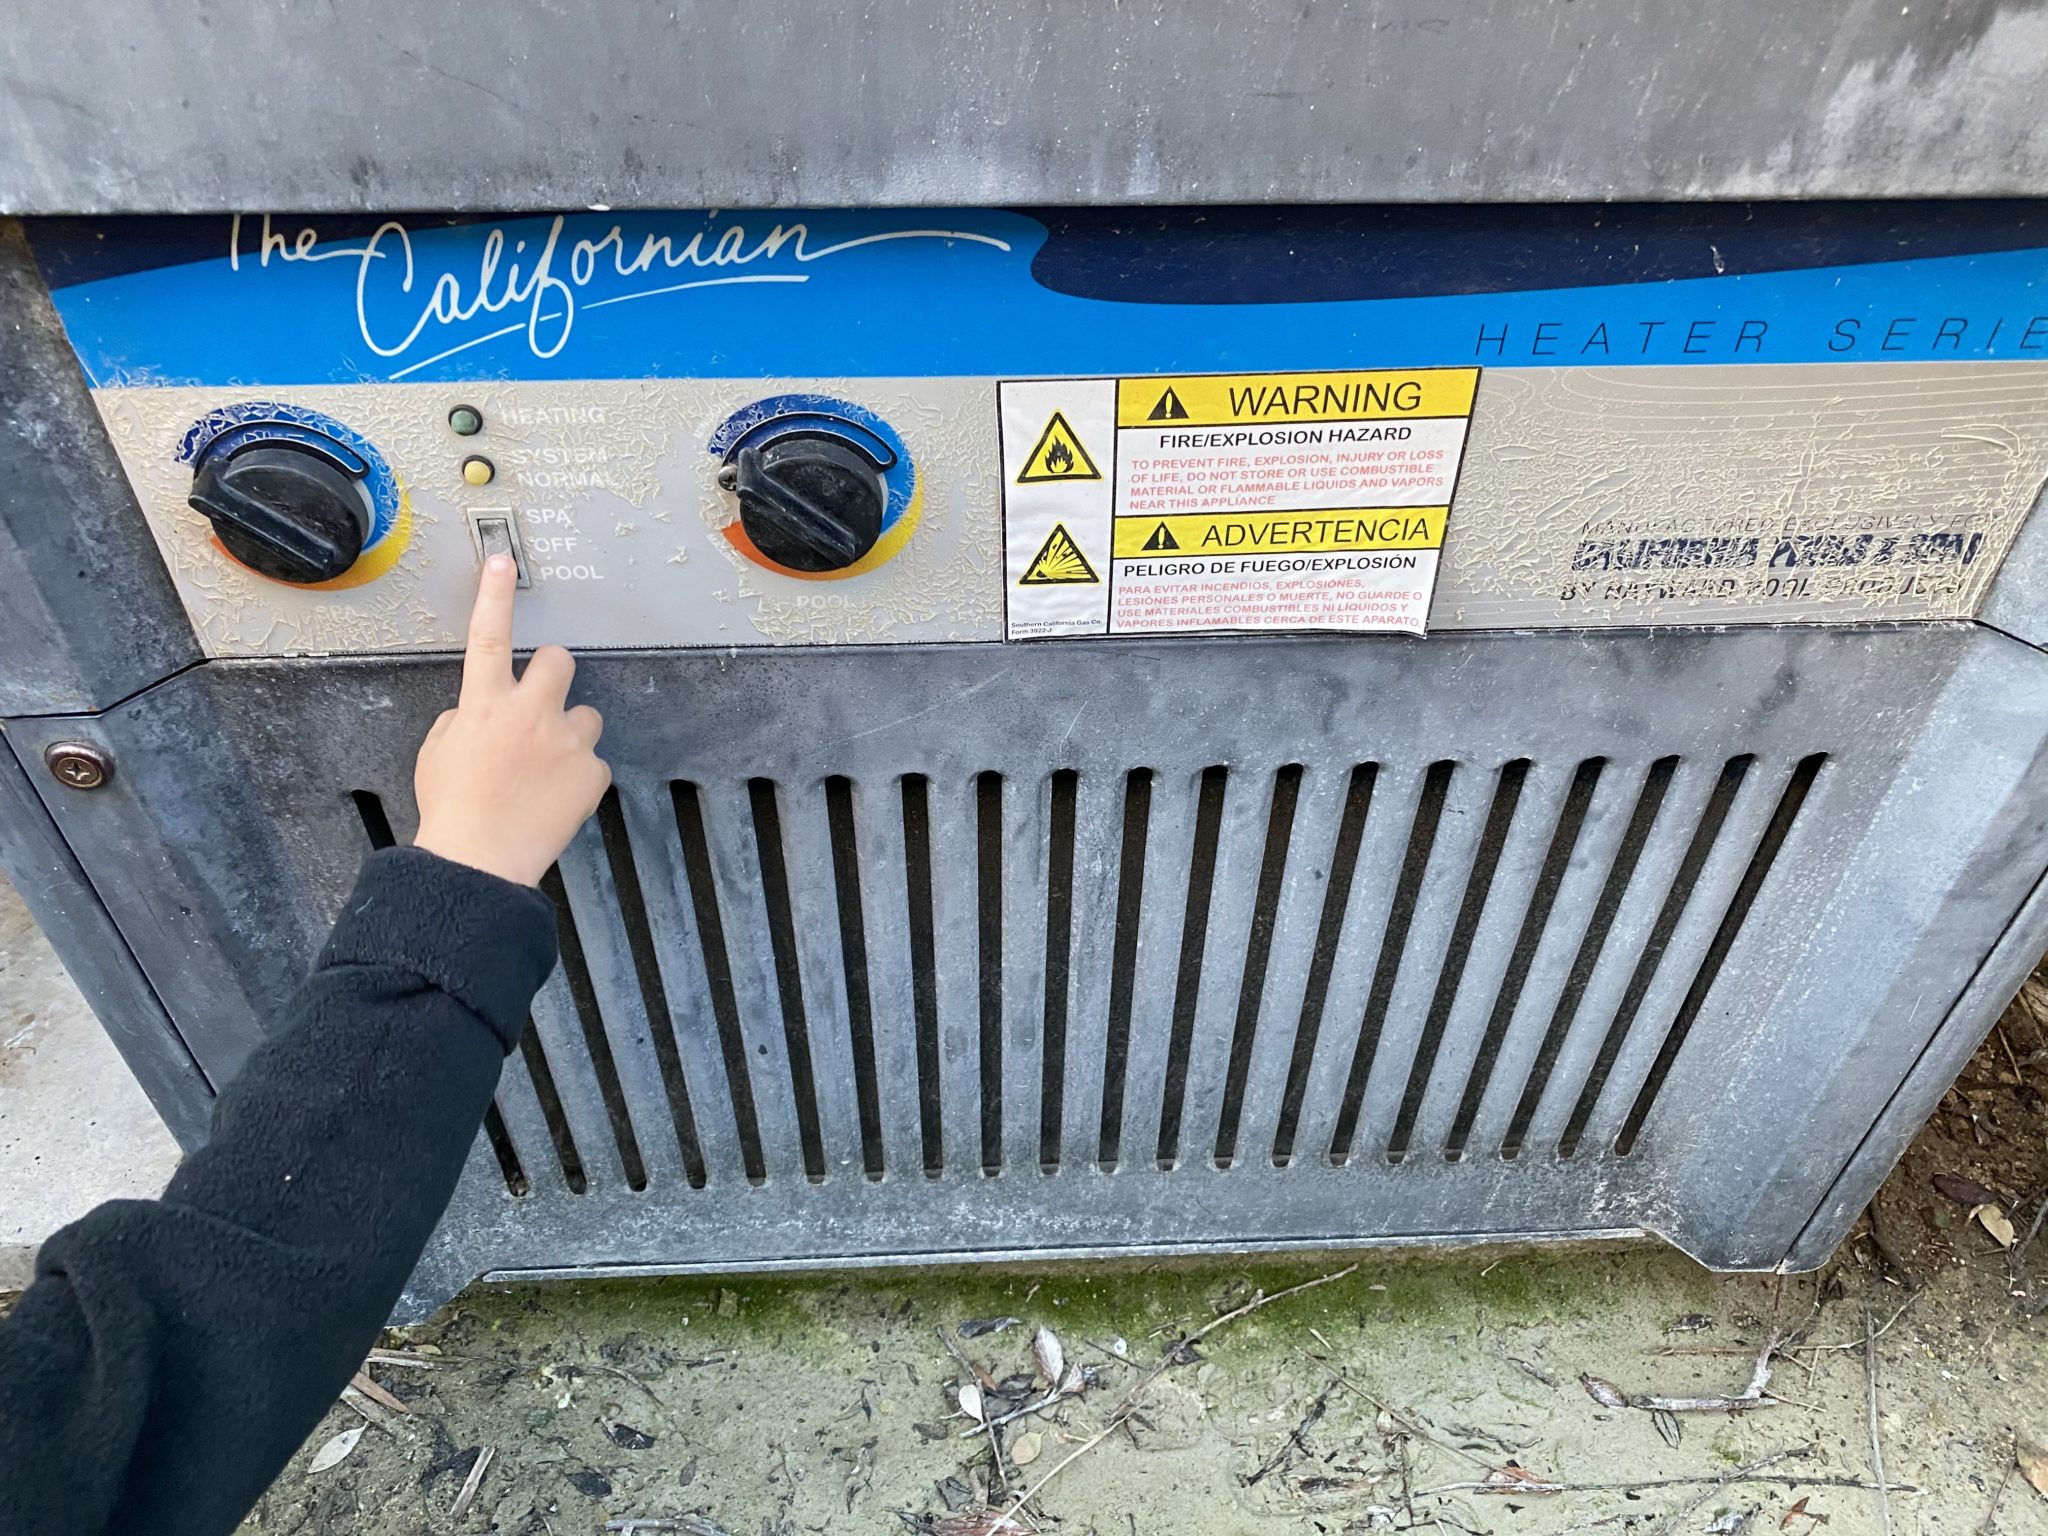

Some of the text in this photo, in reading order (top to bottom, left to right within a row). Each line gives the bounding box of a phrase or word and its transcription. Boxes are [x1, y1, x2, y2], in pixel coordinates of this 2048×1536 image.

[356, 214, 1011, 358] Californian
[1475, 321, 1769, 357] HEATER
[1229, 382, 1422, 416] WARNING
[1160, 426, 1411, 448] FIRE/EXPLOSION HAZARD
[1131, 449, 1444, 470] TO PREVENT FIRE, EXPLOSION, INJURY OR LOSS
[1131, 464, 1434, 484] OF LIFE, DO NOT STORE OR USE COMBUSTIBLE
[1130, 477, 1444, 497] MATERIAL OR FLAMMABLE LIQUIDS AND VAPORS
[1130, 496, 1276, 510] NEAR THIS APPLIANCE
[526, 508, 573, 525] SPA
[1201, 518, 1429, 548] ADVERTENCIA
[533, 537, 578, 553] OFF
[540, 564, 604, 580] POOL
[1124, 554, 1416, 577] PELIGRO DE FUEGO/EXPLOSIÓN
[1118, 586, 1150, 595] PARA
[1154, 585, 1197, 594] EVITAR
[1201, 581, 1272, 591] INCENDIOS,
[1181, 593, 1264, 604] PERSONALES
[1267, 593, 1276, 601] O
[1279, 592, 1332, 601] MUERTE,
[1336, 591, 1355, 600] NO
[1358, 591, 1410, 600] GUARDE
[1413, 591, 1423, 600] O
[1117, 609, 1141, 618] USE
[1144, 606, 1220, 617] MATERIALES
[1223, 604, 1319, 614] COMBUSTIBLES
[1322, 604, 1335, 612] NI
[1400, 603, 1409, 612] Y
[1117, 619, 1174, 628] VAPORES
[1177, 616, 1261, 627] INFLAMABLES
[1264, 616, 1306, 624] CERCA
[1309, 615, 1325, 623] DE
[1328, 615, 1360, 624] ESTE
